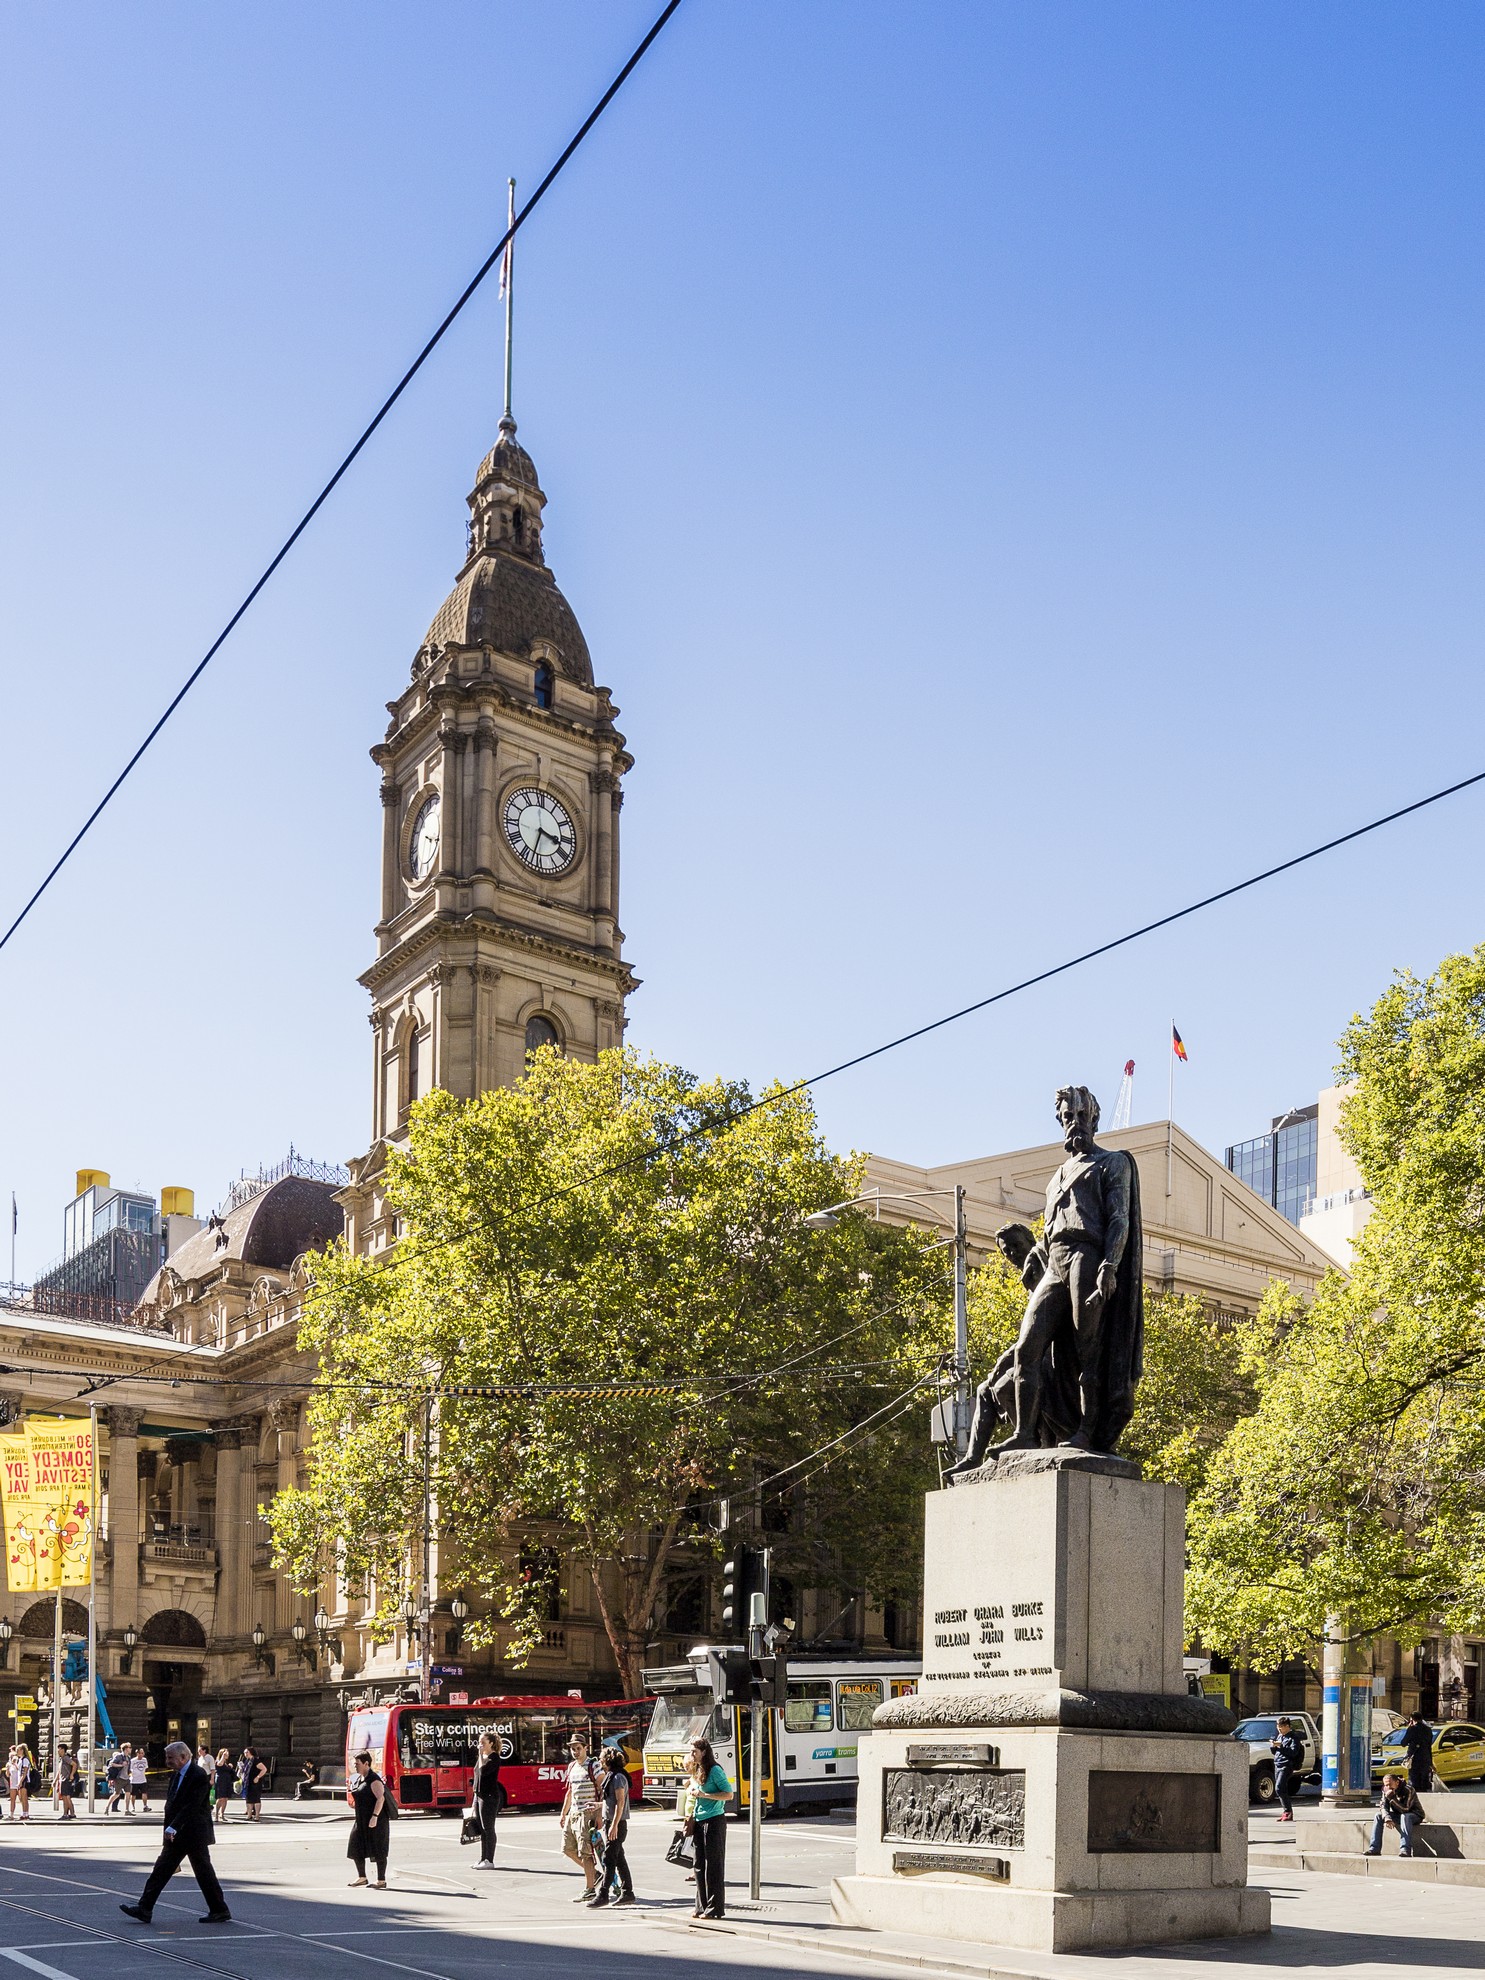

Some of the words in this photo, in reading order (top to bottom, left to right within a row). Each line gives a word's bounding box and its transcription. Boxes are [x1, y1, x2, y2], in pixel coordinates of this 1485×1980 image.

[935, 1609, 968, 1624] ROBERT
[1012, 1602, 1044, 1618] BURKE
[935, 1632, 970, 1648] WILLIAM
[979, 1630, 1004, 1644] JOHN
[1014, 1627, 1044, 1642] WILLS
[415, 1723, 444, 1737] Stay
[447, 1722, 512, 1734] connected
[415, 1739, 434, 1747] Free
[436, 1738, 453, 1747] WiFi
[815, 1750, 832, 1758] yarra
